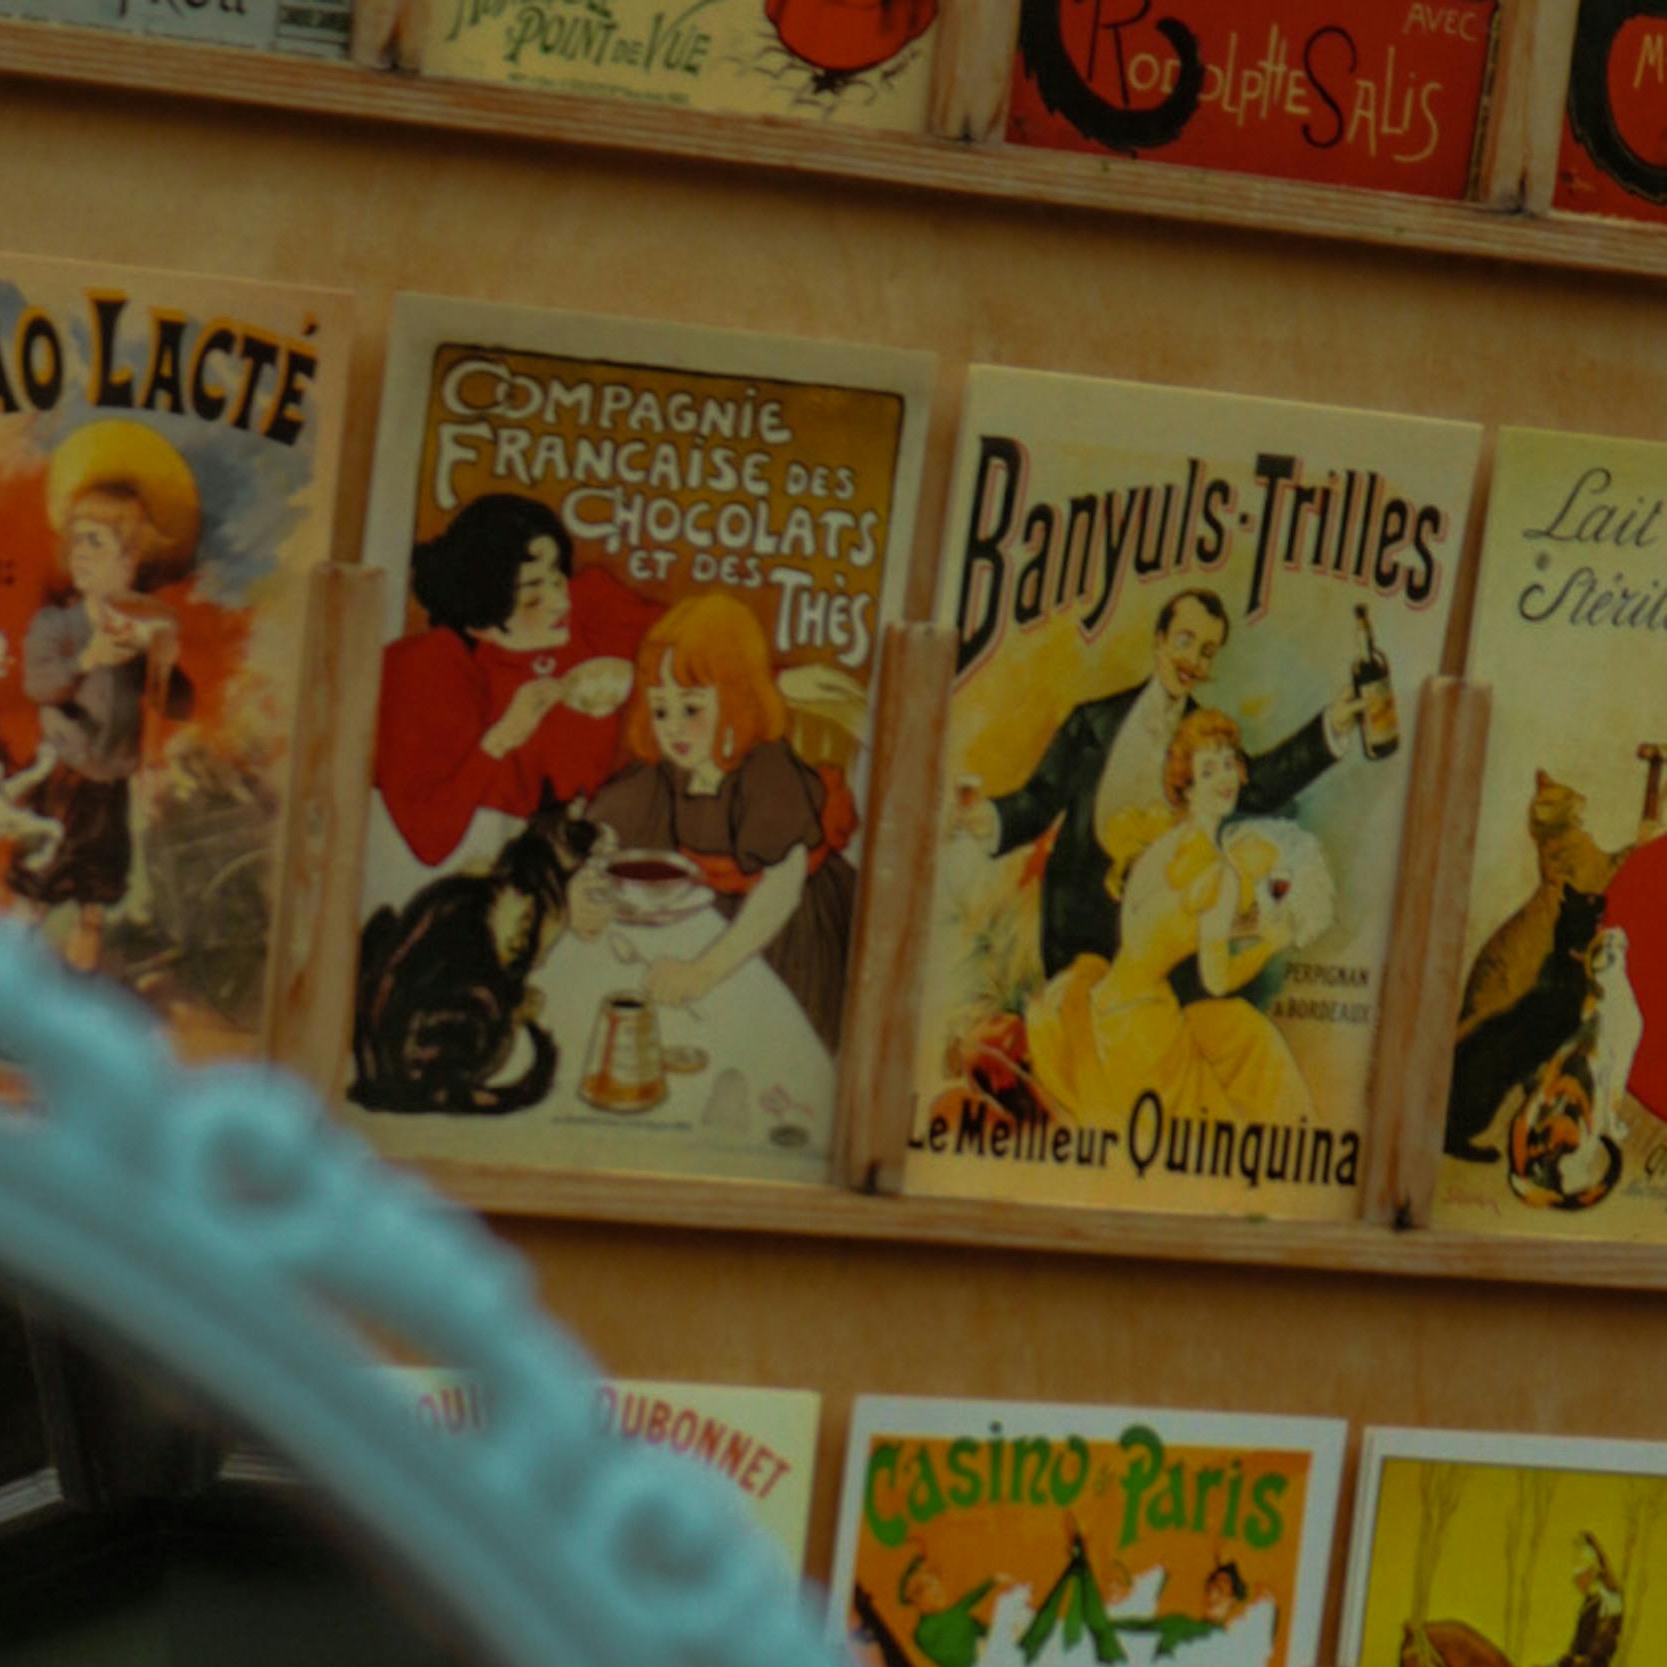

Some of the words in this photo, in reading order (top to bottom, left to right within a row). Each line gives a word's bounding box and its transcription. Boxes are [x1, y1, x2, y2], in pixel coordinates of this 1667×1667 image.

[1402, 2, 1481, 43] AVEC
[784, 462, 857, 501] DES
[562, 486, 880, 568] CHOCOLATS
[627, 548, 678, 582] ET
[691, 551, 762, 589] DES
[955, 1099, 1119, 1169] Meilleur
[1129, 1090, 1362, 1188] Quinquina
[865, 1420, 1090, 1548] Casino
[1118, 1424, 1288, 1550] Paris
